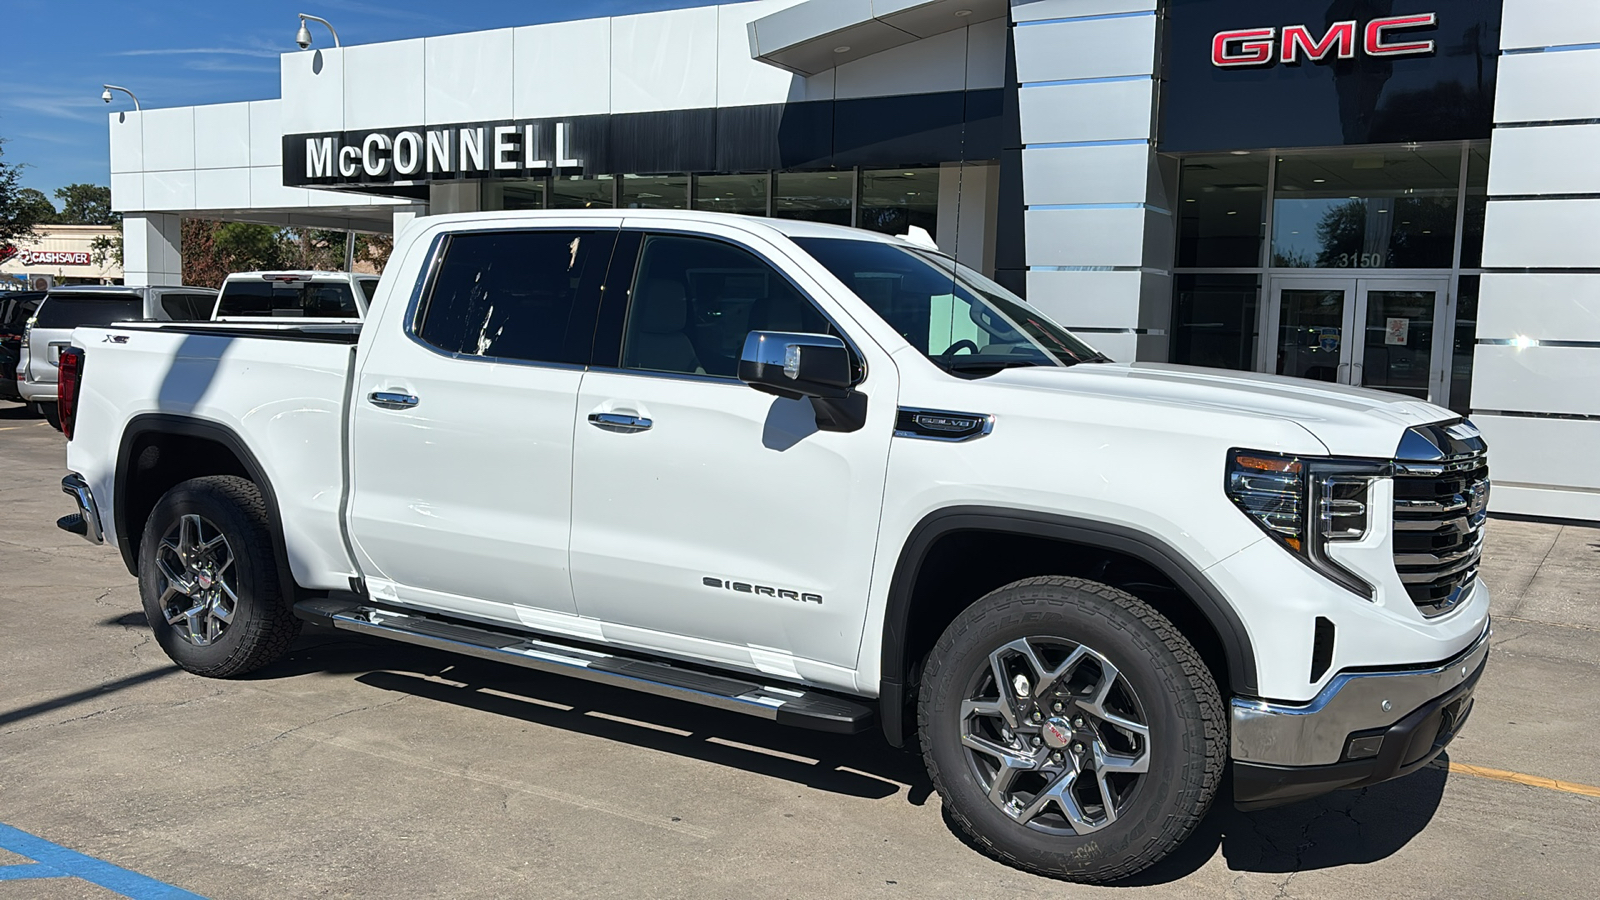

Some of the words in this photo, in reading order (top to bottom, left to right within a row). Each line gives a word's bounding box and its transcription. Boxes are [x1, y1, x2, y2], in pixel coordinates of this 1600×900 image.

[1211, 12, 1437, 67] GMC
[1339, 252, 1381, 268] 3150
[702, 576, 823, 605] SIERRA
